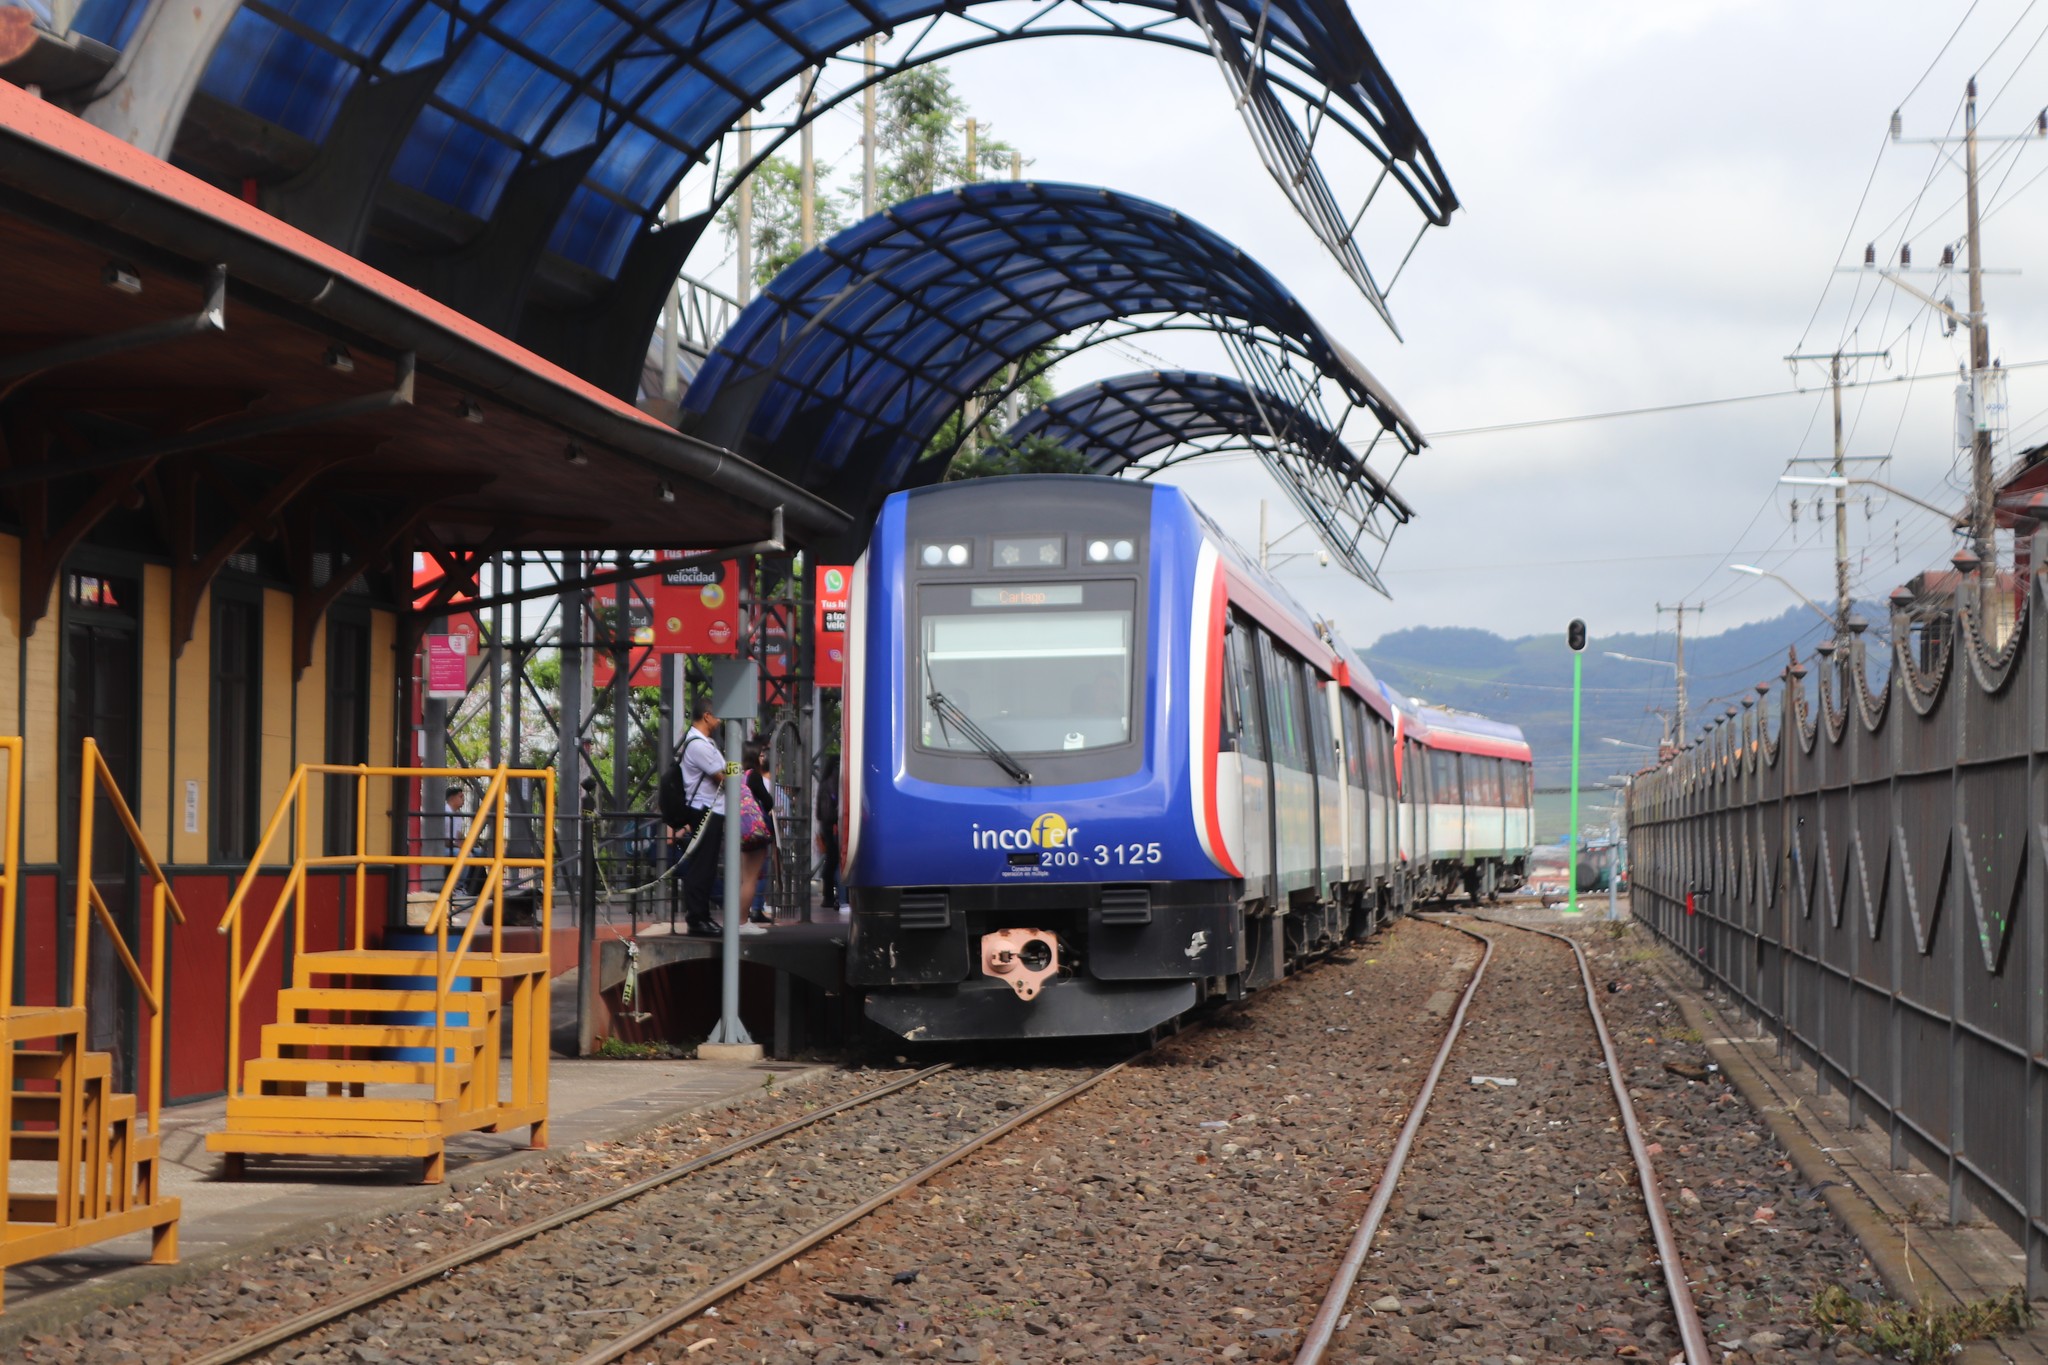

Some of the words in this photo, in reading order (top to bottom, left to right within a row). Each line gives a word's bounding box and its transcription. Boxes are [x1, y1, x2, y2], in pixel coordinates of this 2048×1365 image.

[667, 572, 716, 583] velocidad
[999, 589, 1047, 604] Cartago
[821, 599, 837, 608] Tus
[972, 813, 1079, 850] incofer
